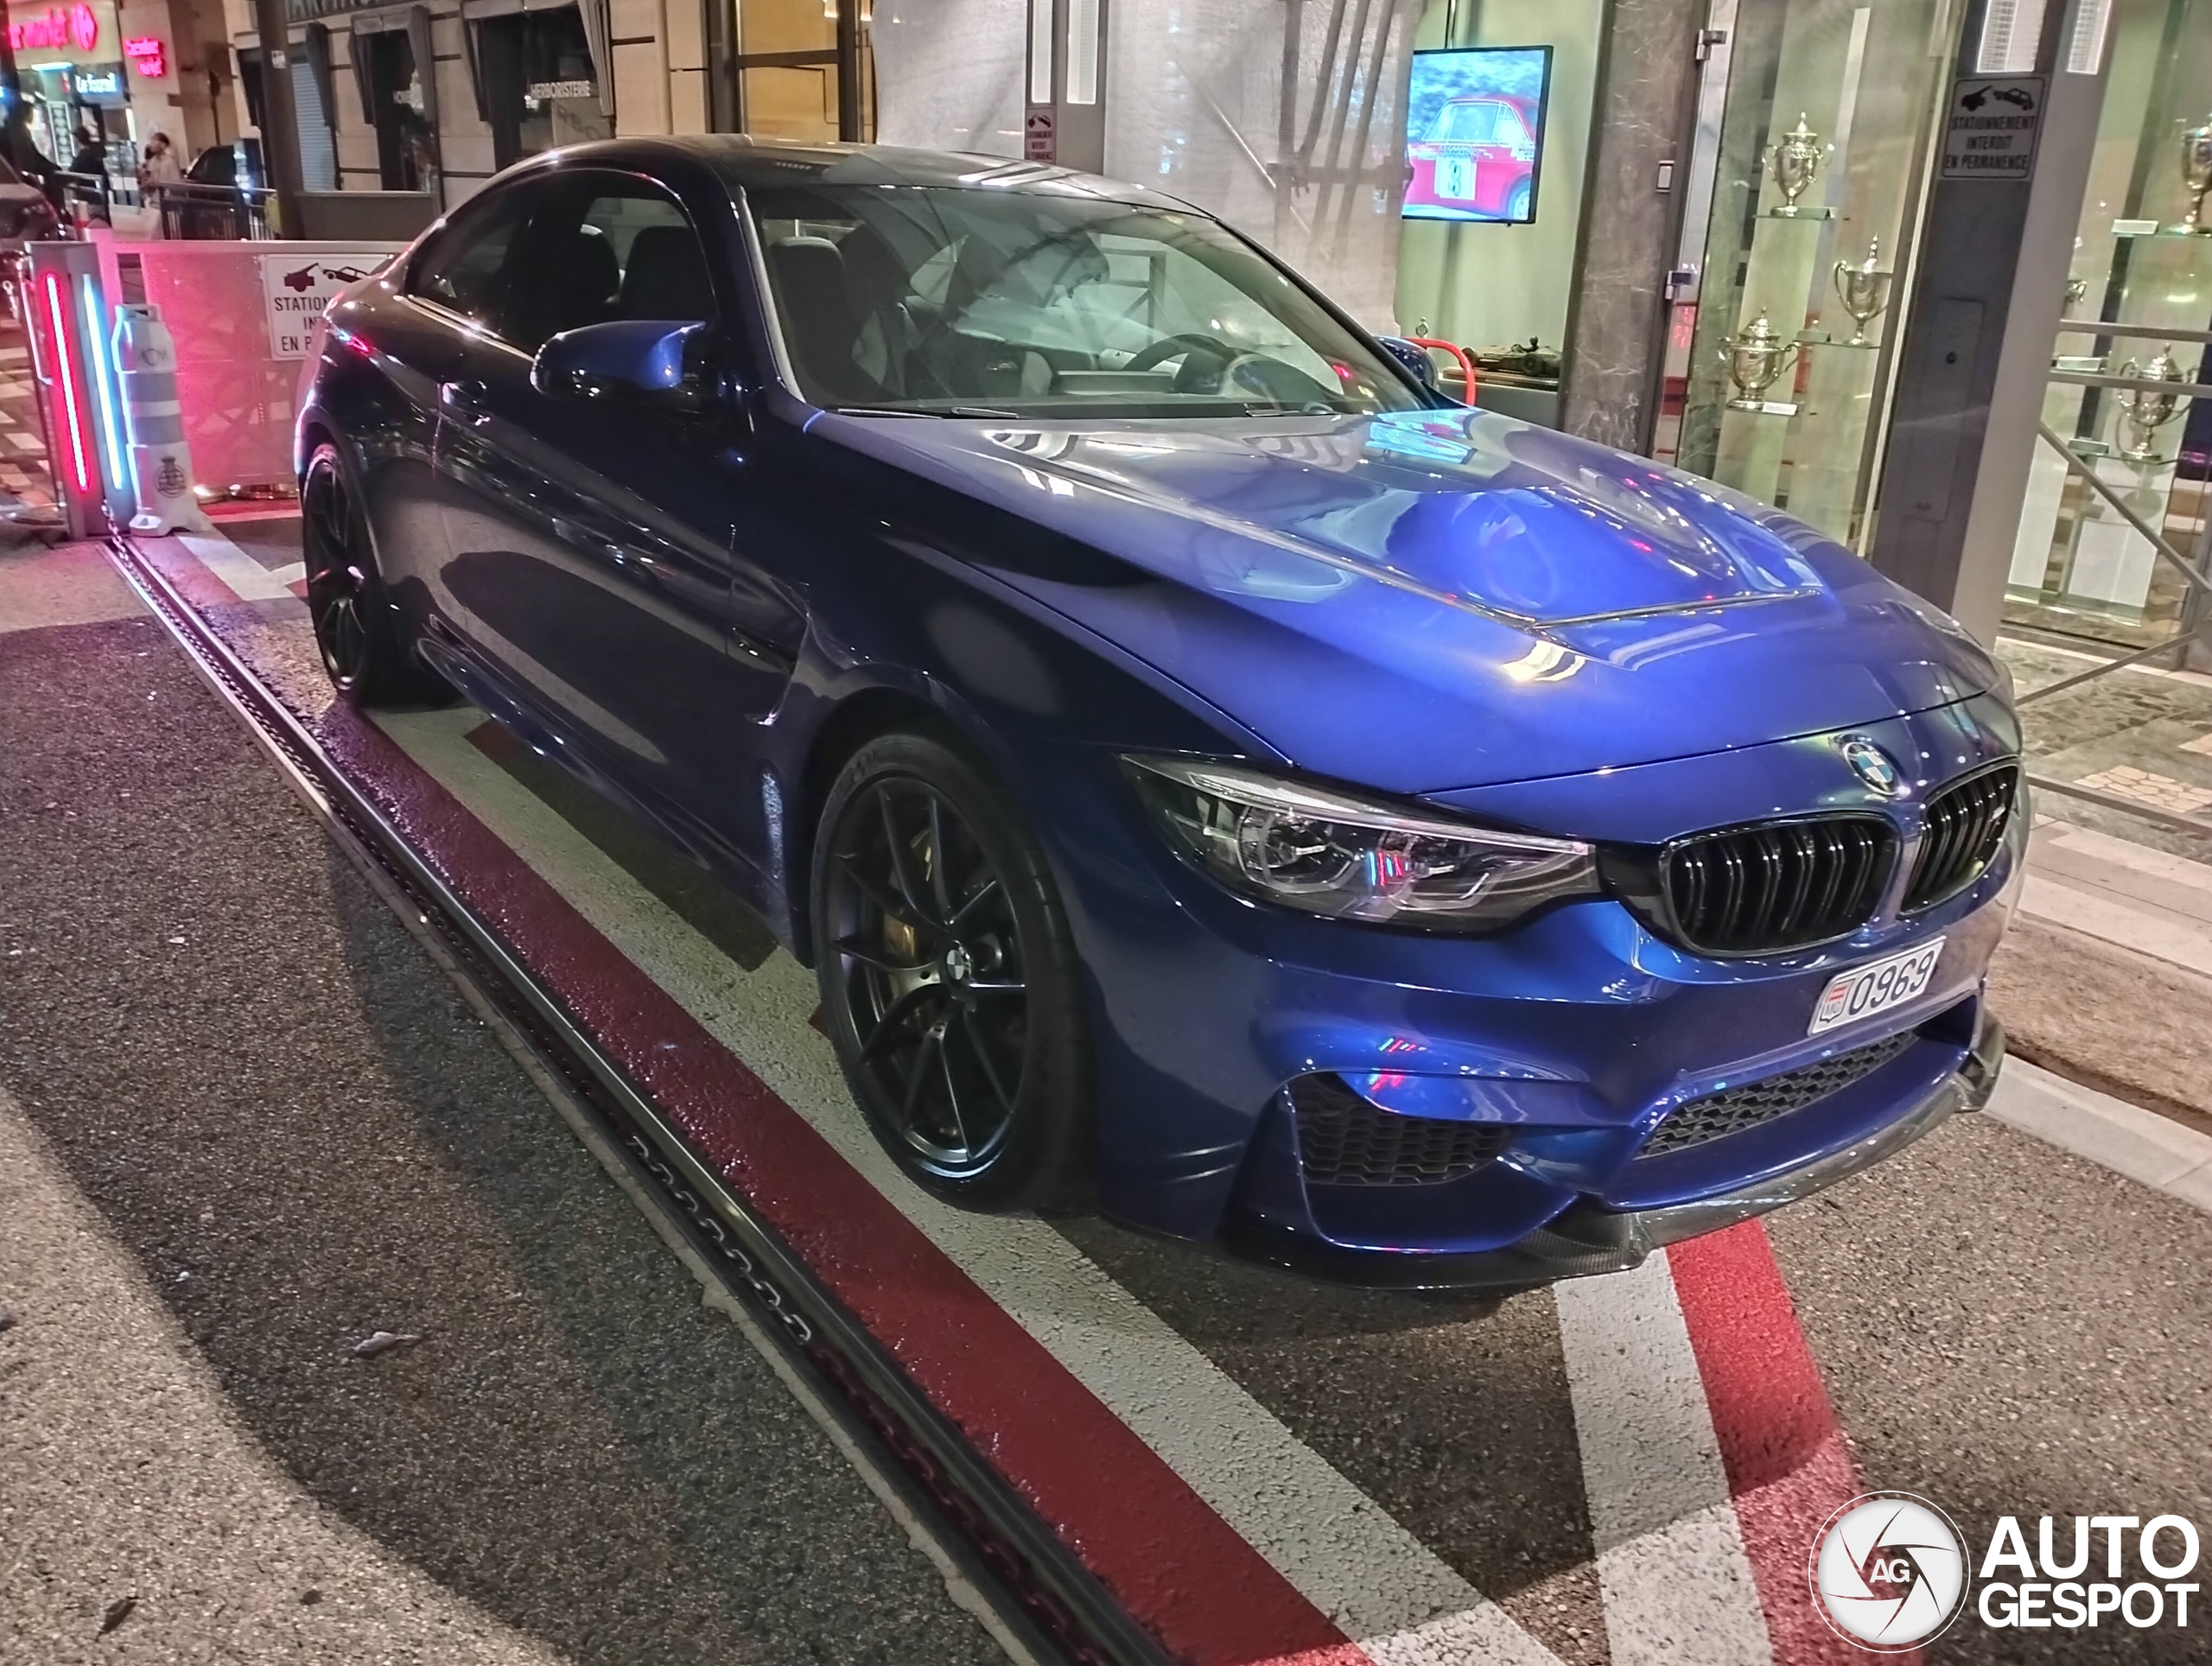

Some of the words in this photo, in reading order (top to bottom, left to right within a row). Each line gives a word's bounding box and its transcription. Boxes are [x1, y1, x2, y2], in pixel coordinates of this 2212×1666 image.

[531, 80, 591, 99] HERBORISTERIE
[1952, 115, 2037, 130] STATIONNEMENT
[1966, 135, 2013, 150] INTERDIT
[281, 336, 299, 352] EN
[1849, 950, 1935, 1016] 0969
